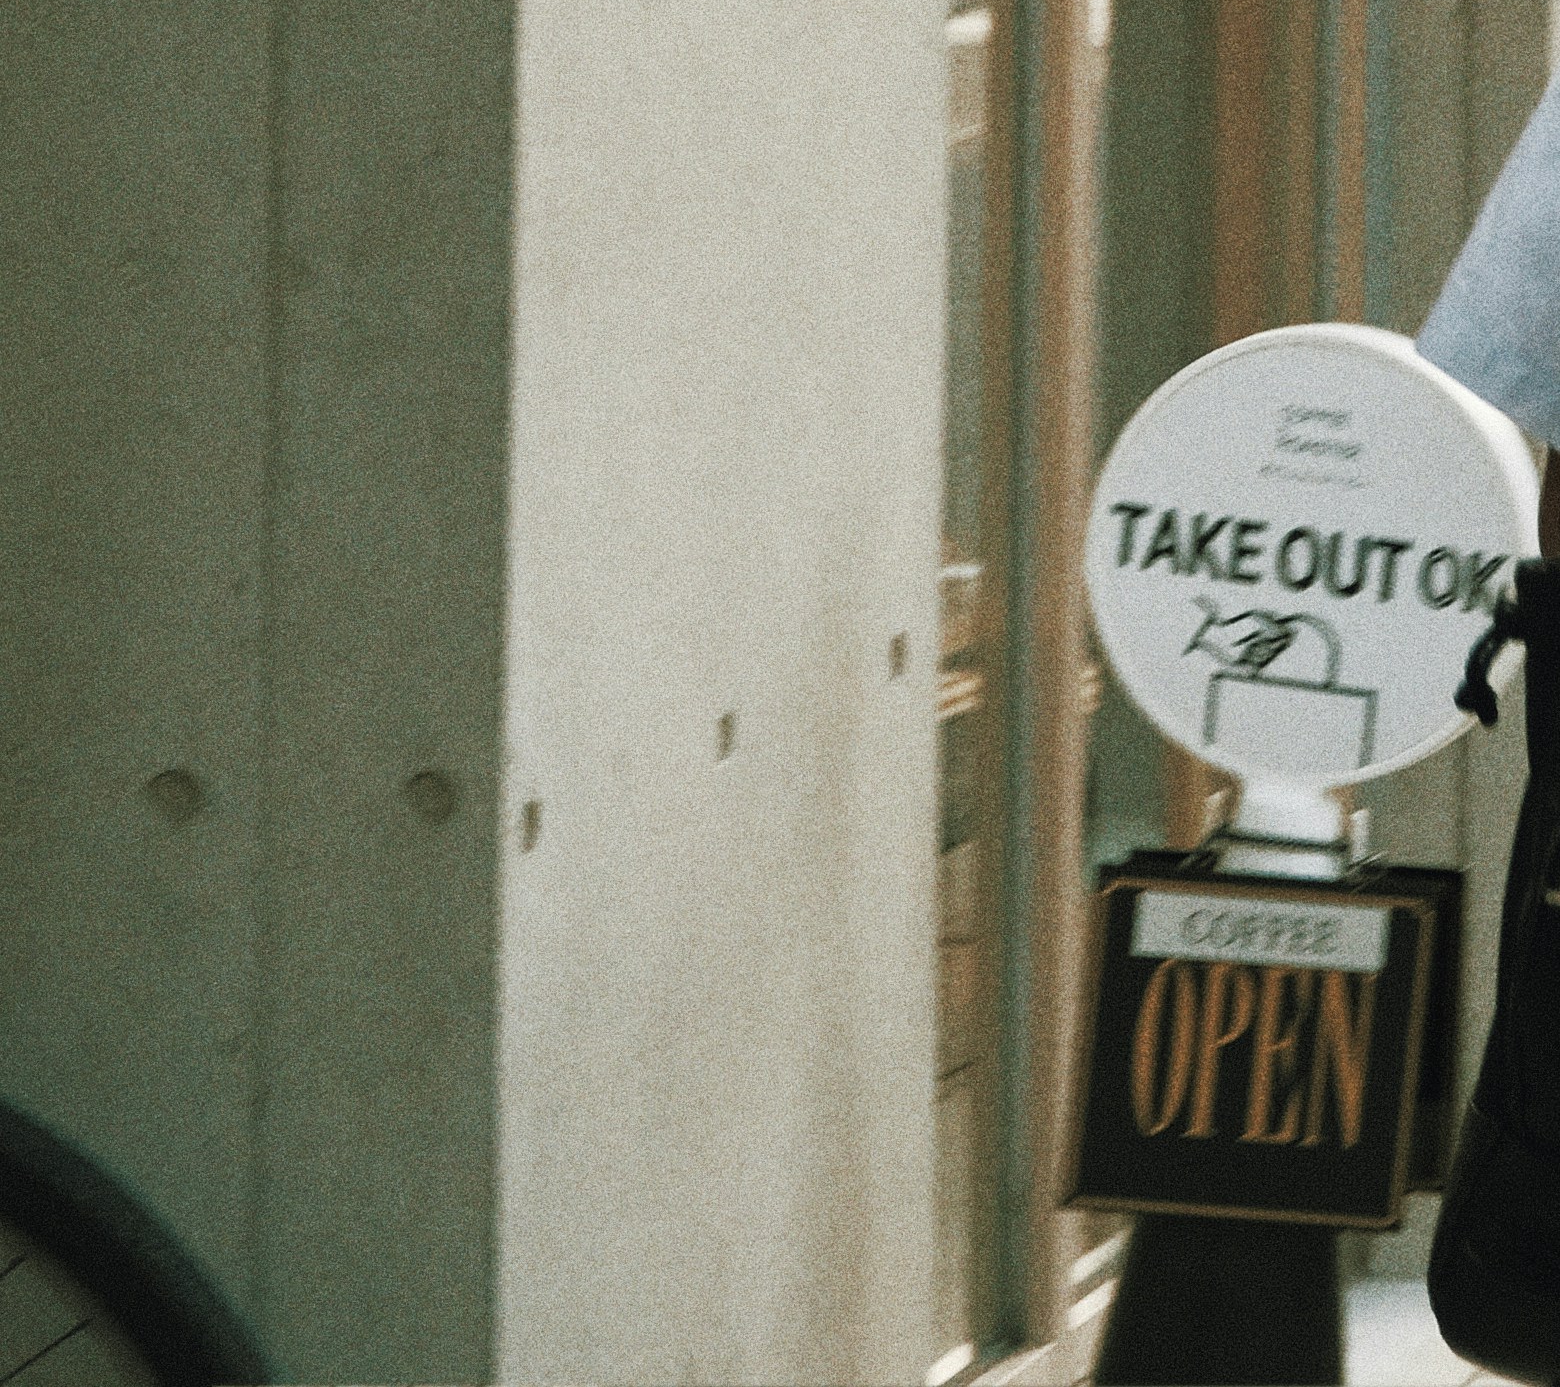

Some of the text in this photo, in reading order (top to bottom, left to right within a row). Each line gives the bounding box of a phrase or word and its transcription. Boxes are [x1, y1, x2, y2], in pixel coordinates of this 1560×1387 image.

[1108, 501, 1512, 615] TAKE OUT OK
[1179, 908, 1342, 956] COFFEE
[1130, 956, 1379, 1150] OPEN
